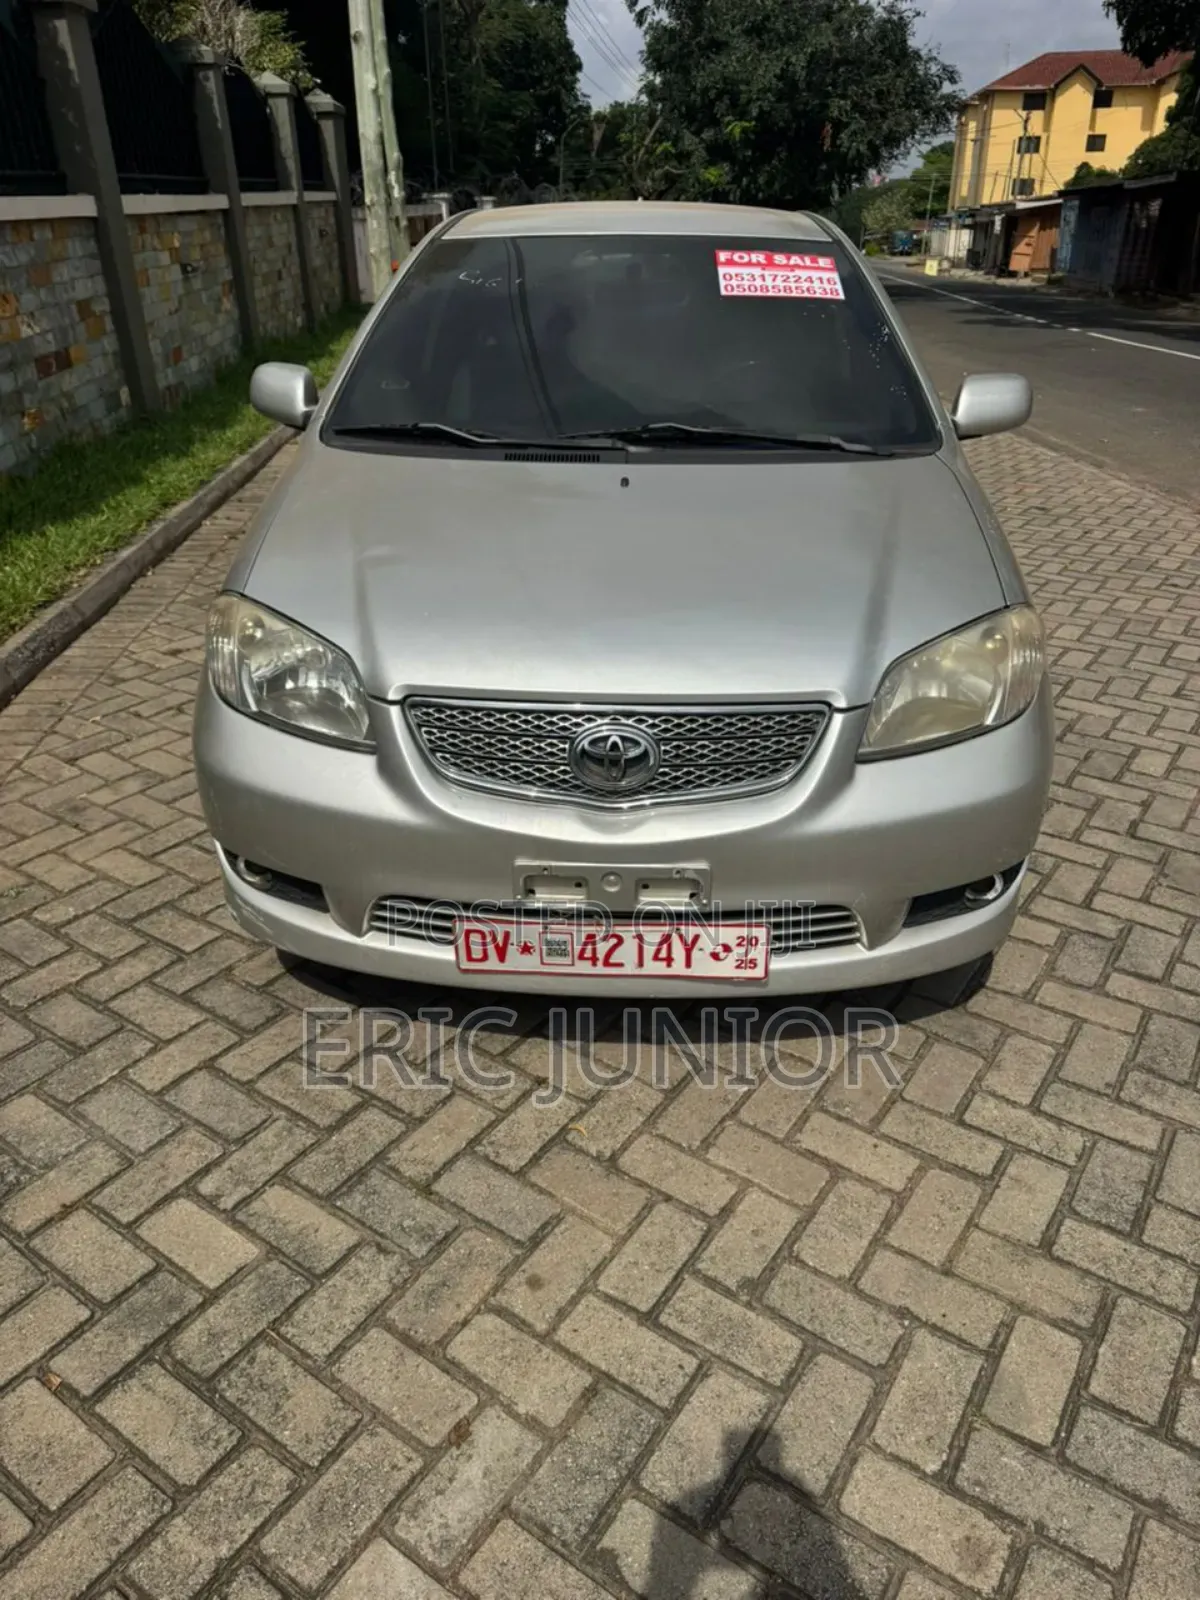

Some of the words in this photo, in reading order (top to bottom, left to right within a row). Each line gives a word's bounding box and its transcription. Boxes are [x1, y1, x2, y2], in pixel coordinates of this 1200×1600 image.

[719, 252, 766, 264] FOR
[773, 254, 833, 268] SALE
[722, 272, 837, 286] 0531722416
[723, 283, 840, 297] 0508585638
[735, 934, 760, 948] 20
[464, 928, 511, 963] DV
[577, 932, 701, 969] 4214Y
[734, 958, 758, 970] 25
